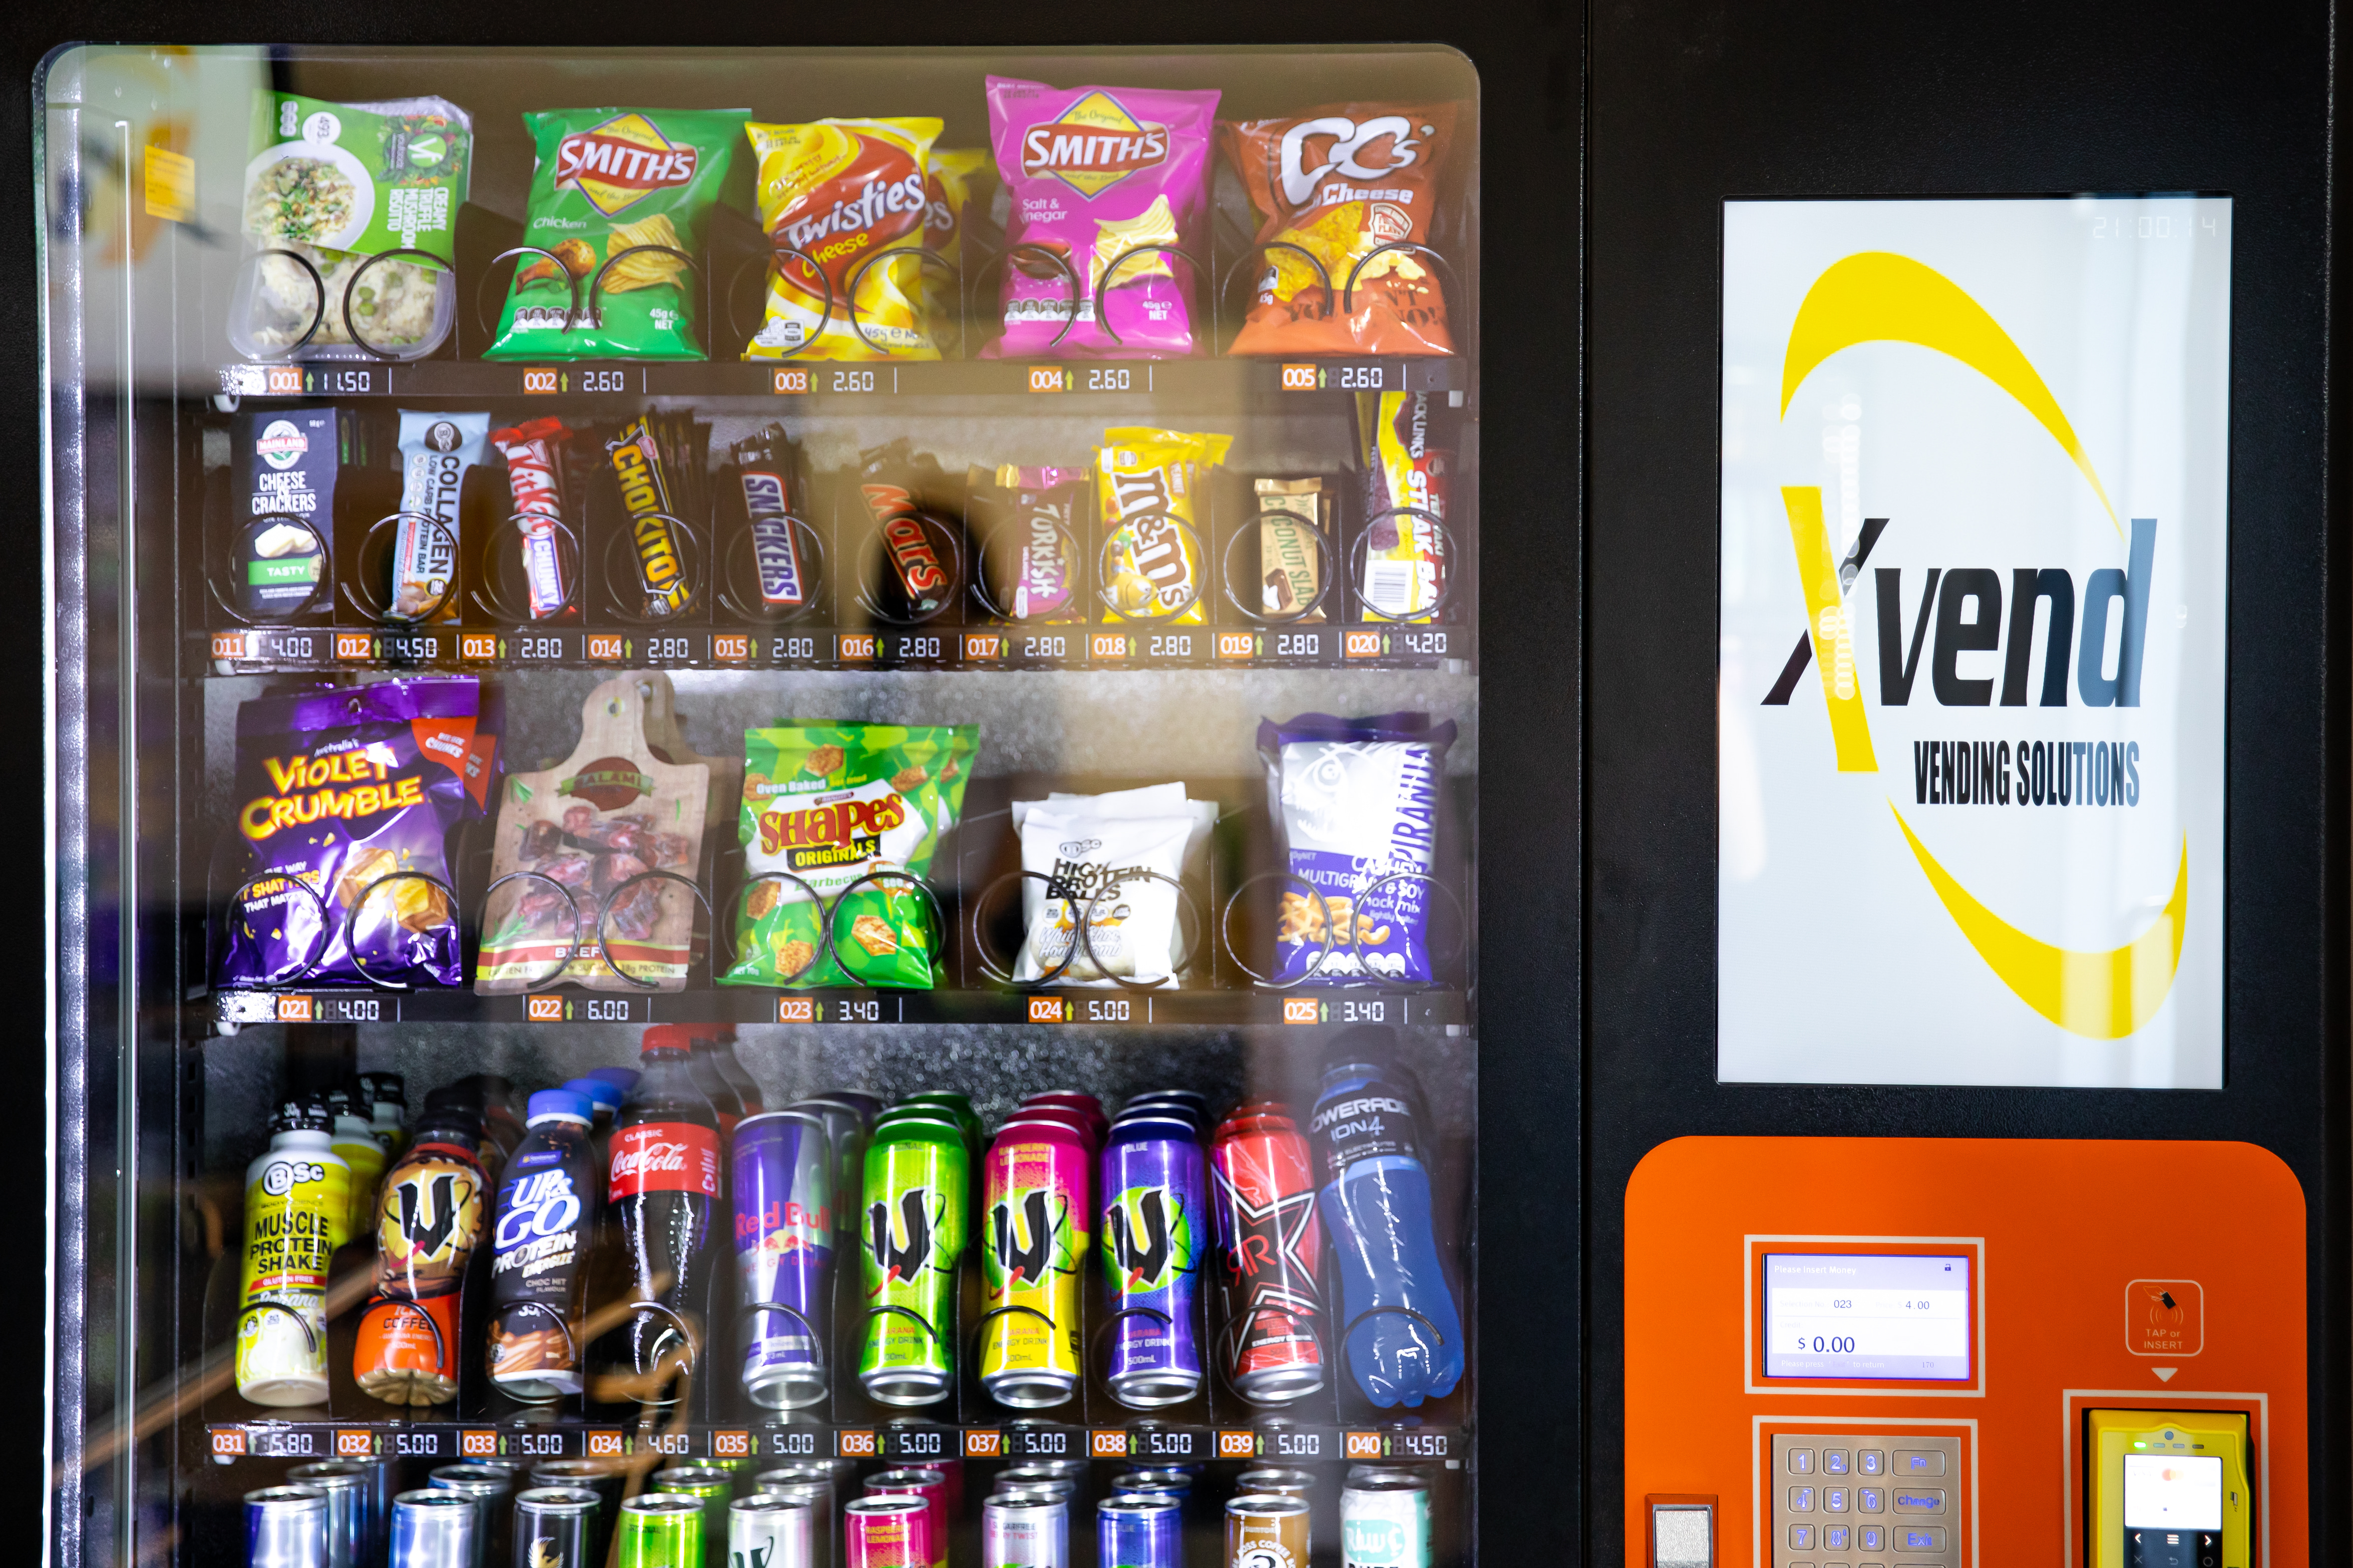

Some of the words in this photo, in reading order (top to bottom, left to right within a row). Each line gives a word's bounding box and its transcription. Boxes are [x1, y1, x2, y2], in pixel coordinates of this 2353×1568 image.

[1025, 130, 1165, 166] SMITH'S
[559, 140, 695, 181] SMITH'S
[1022, 199, 1047, 209] Salt
[1049, 198, 1059, 209] &
[1321, 183, 1414, 206] Cheese
[387, 189, 404, 232] RISOTTO
[400, 188, 419, 248] MUSHROOM
[418, 188, 434, 232] TRUFFLE
[432, 187, 449, 231] CREAMY
[775, 174, 925, 249] Twisties
[533, 216, 586, 229] Chicken
[2093, 216, 2216, 239] 21:00:14
[802, 232, 869, 278] Cheese
[650, 307, 668, 320] 45g
[1149, 310, 1167, 321] NET
[655, 318, 674, 330] NET
[270, 372, 301, 390] 001
[525, 373, 556, 390] 002
[583, 371, 623, 391] 2.60
[775, 373, 806, 390] 003
[834, 371, 874, 391] 2.60
[1031, 371, 1062, 388] 004
[1089, 369, 1129, 389] 2.60
[1284, 368, 1315, 386] 005
[1342, 368, 1382, 387] 2.60
[259, 471, 306, 492] CHEESE
[252, 493, 316, 515] CRACKERS
[429, 456, 460, 574] COLLAGEN
[613, 444, 679, 584] CHOKITO
[267, 566, 305, 577] TASTY
[533, 541, 561, 609] CHUNKY
[213, 639, 244, 657] 011
[271, 638, 311, 657] 4.00
[338, 639, 369, 656] 012
[397, 638, 437, 658] 4.50
[464, 639, 495, 657] 013
[522, 639, 562, 658] 2.80
[591, 640, 621, 657] 014
[648, 639, 688, 658] 2.80
[716, 640, 746, 657] 015
[773, 638, 813, 658] 2.80
[843, 639, 873, 656] 016
[900, 638, 939, 657] 2.80
[968, 639, 999, 656] 017
[1025, 637, 1065, 656] 2.80
[1094, 638, 1125, 655] 018
[1150, 636, 1191, 656] 2.80
[1221, 636, 1253, 654] 019
[1278, 635, 1318, 655] 2.80
[1348, 635, 1380, 653] 020
[1406, 633, 1446, 653] 4.20
[1914, 741, 2011, 805] VENDING
[2016, 741, 2141, 807] SOLUTIONS
[756, 783, 787, 794] Oven
[788, 778, 826, 792] Baked
[240, 776, 424, 841] CRUMBLE
[795, 839, 876, 867] ORIGINALS
[244, 897, 269, 913] THAT
[280, 1000, 310, 1018] 021
[339, 1000, 378, 1020] 4.00
[530, 1000, 561, 1017] 022
[588, 1000, 628, 1020] 6.00
[781, 1001, 811, 1019] 023
[840, 1001, 878, 1020] 3.40
[1030, 1001, 1062, 1018] 024
[1089, 1001, 1129, 1020] 5.00
[1286, 1002, 1316, 1020] 025
[1344, 1002, 1384, 1021] 3.40
[624, 1129, 663, 1142] CLASSIC
[1330, 1115, 1386, 1142] ION4
[1125, 1142, 1148, 1152] BLUE
[255, 1211, 328, 1240] MUSCLE
[495, 1195, 581, 1250] GO
[735, 1202, 780, 1240] Red
[785, 1202, 831, 1234] Bull
[250, 1238, 331, 1260] PROTEIN
[492, 1230, 578, 1279] PROTEIN
[258, 1255, 322, 1274] SHAKE
[1774, 1265, 1801, 1275] Please
[1803, 1265, 1827, 1274] Insert
[1829, 1266, 1856, 1276] Money
[295, 1276, 315, 1284] FREE
[1834, 1300, 1852, 1309] 023
[2146, 1329, 2167, 1338] TAP
[1798, 1337, 1806, 1350] $
[1813, 1336, 1855, 1353] 0.00
[2144, 1341, 2183, 1350] INSERT
[1128, 1354, 1156, 1366] 500mL
[1781, 1360, 1803, 1368] Please
[214, 1434, 244, 1452] 031
[271, 1433, 312, 1453] 5.80
[338, 1435, 370, 1453] 032
[397, 1434, 437, 1453] 5.00
[464, 1435, 495, 1453] 033
[522, 1435, 562, 1454] 5.00
[591, 1436, 622, 1453] 034
[648, 1434, 688, 1454] 4.60
[716, 1435, 747, 1452] 035
[773, 1434, 813, 1453] 5.00
[843, 1435, 874, 1452] 036
[900, 1434, 940, 1453] 5.00
[968, 1434, 999, 1451] 037
[1025, 1433, 1065, 1452] 5.00
[1094, 1434, 1126, 1452] 038
[1151, 1434, 1191, 1453] 5.00
[1221, 1435, 1253, 1452] 039
[1279, 1435, 1319, 1454] 5.00
[1348, 1436, 1380, 1453] 040
[1406, 1436, 1446, 1455] 4.50
[1798, 1454, 1806, 1469] 1
[1830, 1454, 1841, 1470] 2
[1866, 1455, 1877, 1471] 3
[1911, 1457, 1927, 1470] Fn
[1797, 1493, 1808, 1508] 4
[1831, 1492, 1842, 1508] 5
[1866, 1493, 1877, 1508] 6
[1797, 1529, 1807, 1545] 7
[1831, 1530, 1842, 1546] 8
[1866, 1531, 1877, 1547] 9
[1907, 1533, 1932, 1546] Exit
